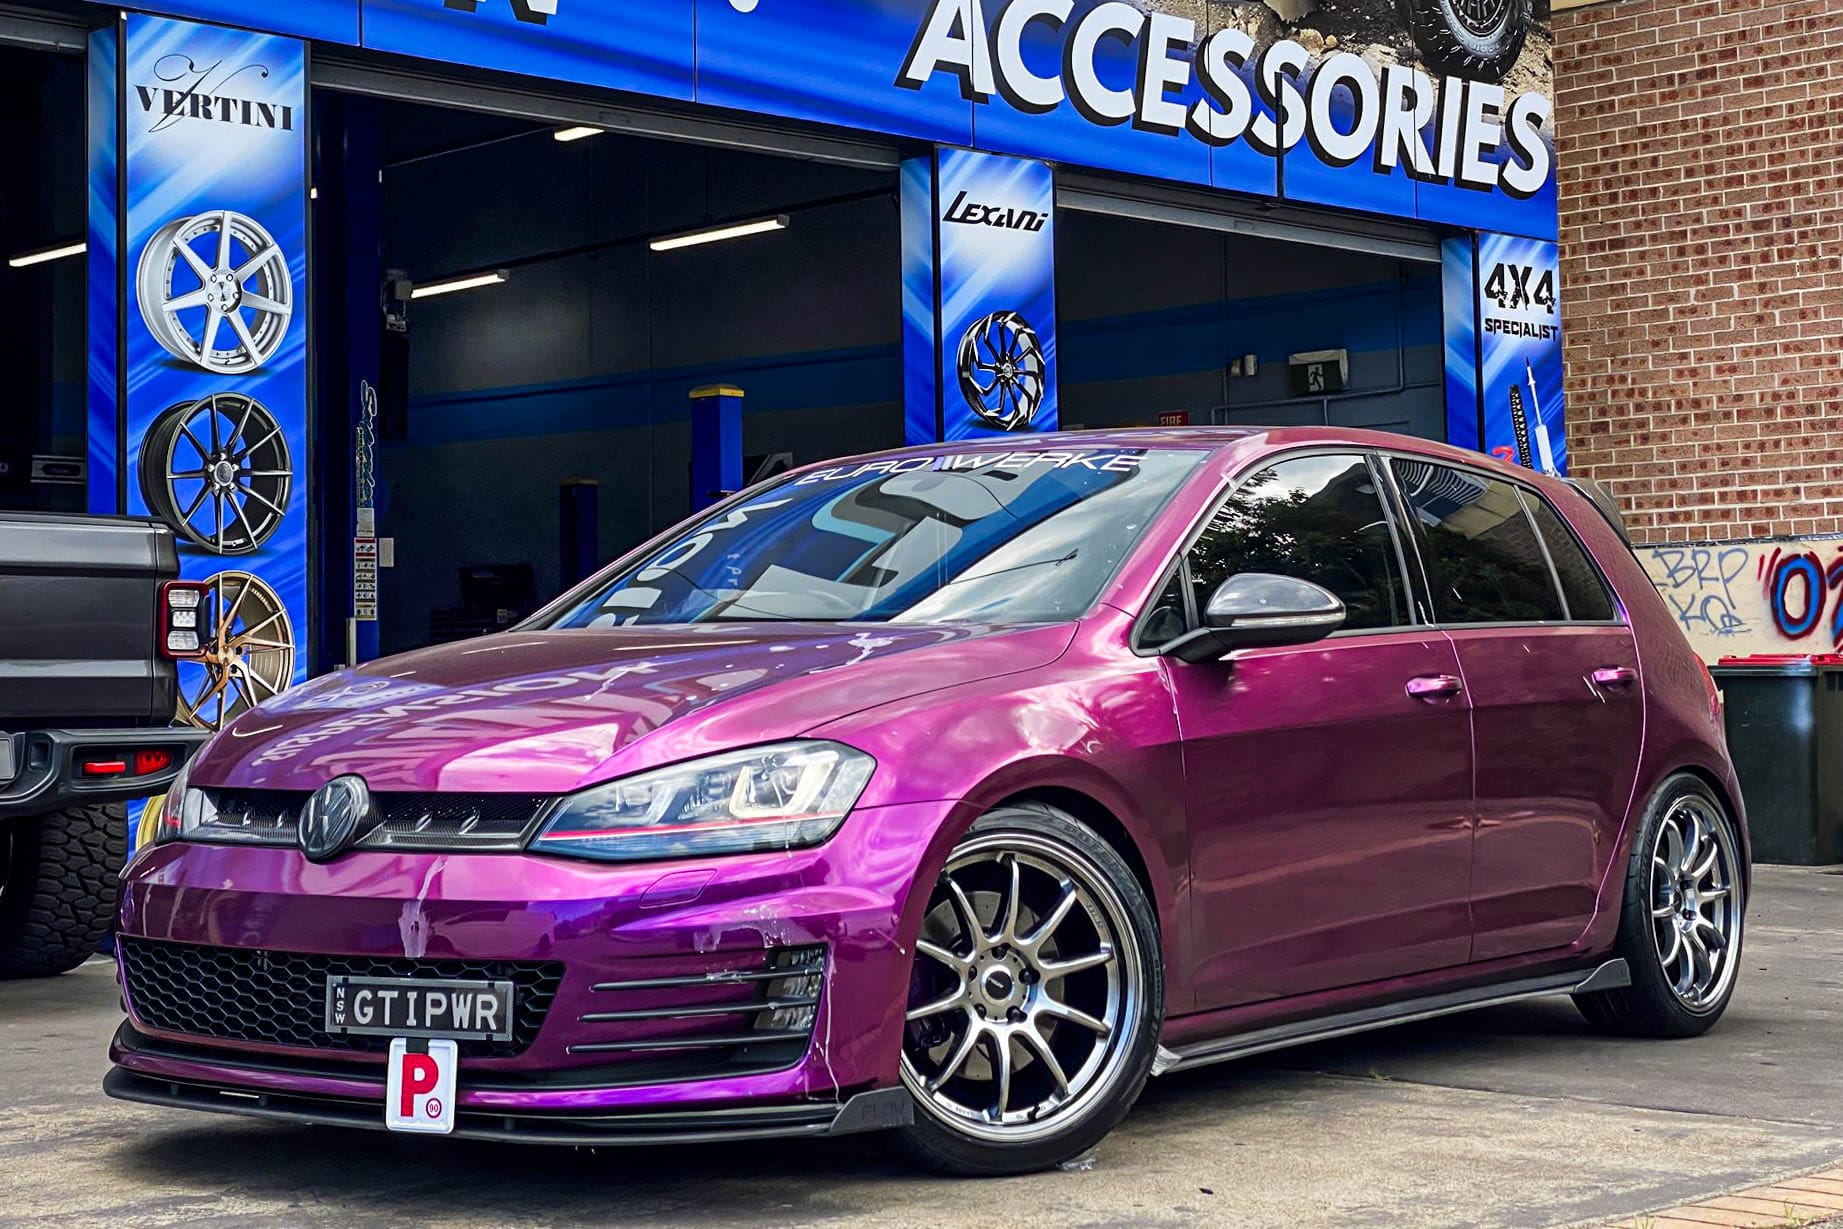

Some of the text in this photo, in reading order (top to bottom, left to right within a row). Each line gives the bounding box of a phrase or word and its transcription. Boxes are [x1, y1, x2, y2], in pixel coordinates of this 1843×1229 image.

[134, 84, 293, 131] VERTINI
[903, 0, 1551, 193] ACCESSORIES
[1484, 262, 1556, 315] 4X4
[1484, 317, 1559, 342] SPECIALIST
[353, 989, 498, 1030] GTIPWR
[400, 1053, 439, 1118] P
[428, 1103, 439, 1113] 90
